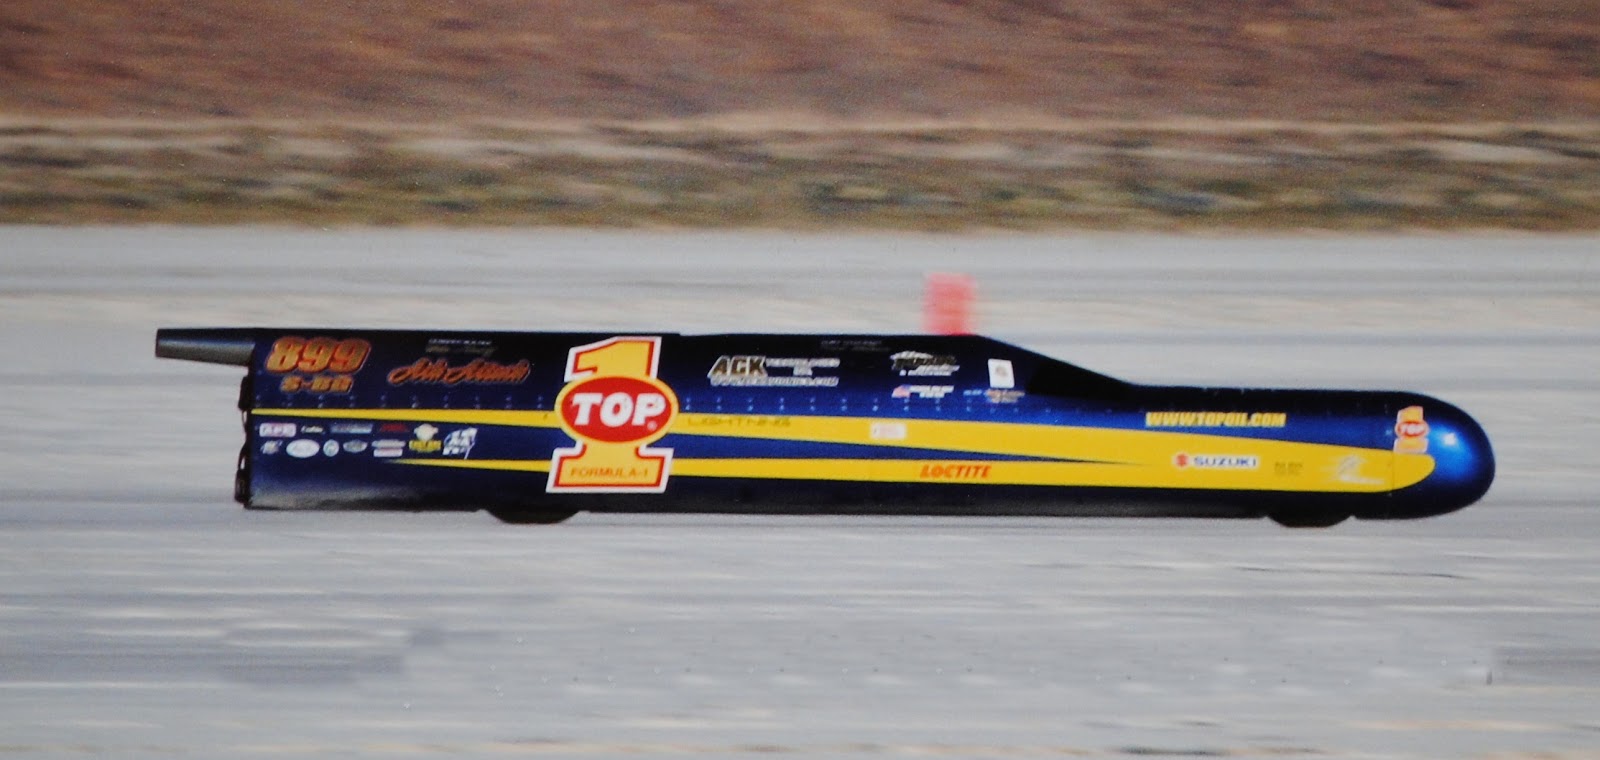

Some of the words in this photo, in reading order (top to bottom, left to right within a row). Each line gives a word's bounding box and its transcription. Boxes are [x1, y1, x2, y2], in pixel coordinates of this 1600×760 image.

[265, 337, 371, 373] 899
[572, 392, 667, 427] TOP
[1194, 457, 1257, 466] SUZUKI
[570, 467, 648, 478] FORMULA-1
[919, 464, 991, 479] LOCTITE
